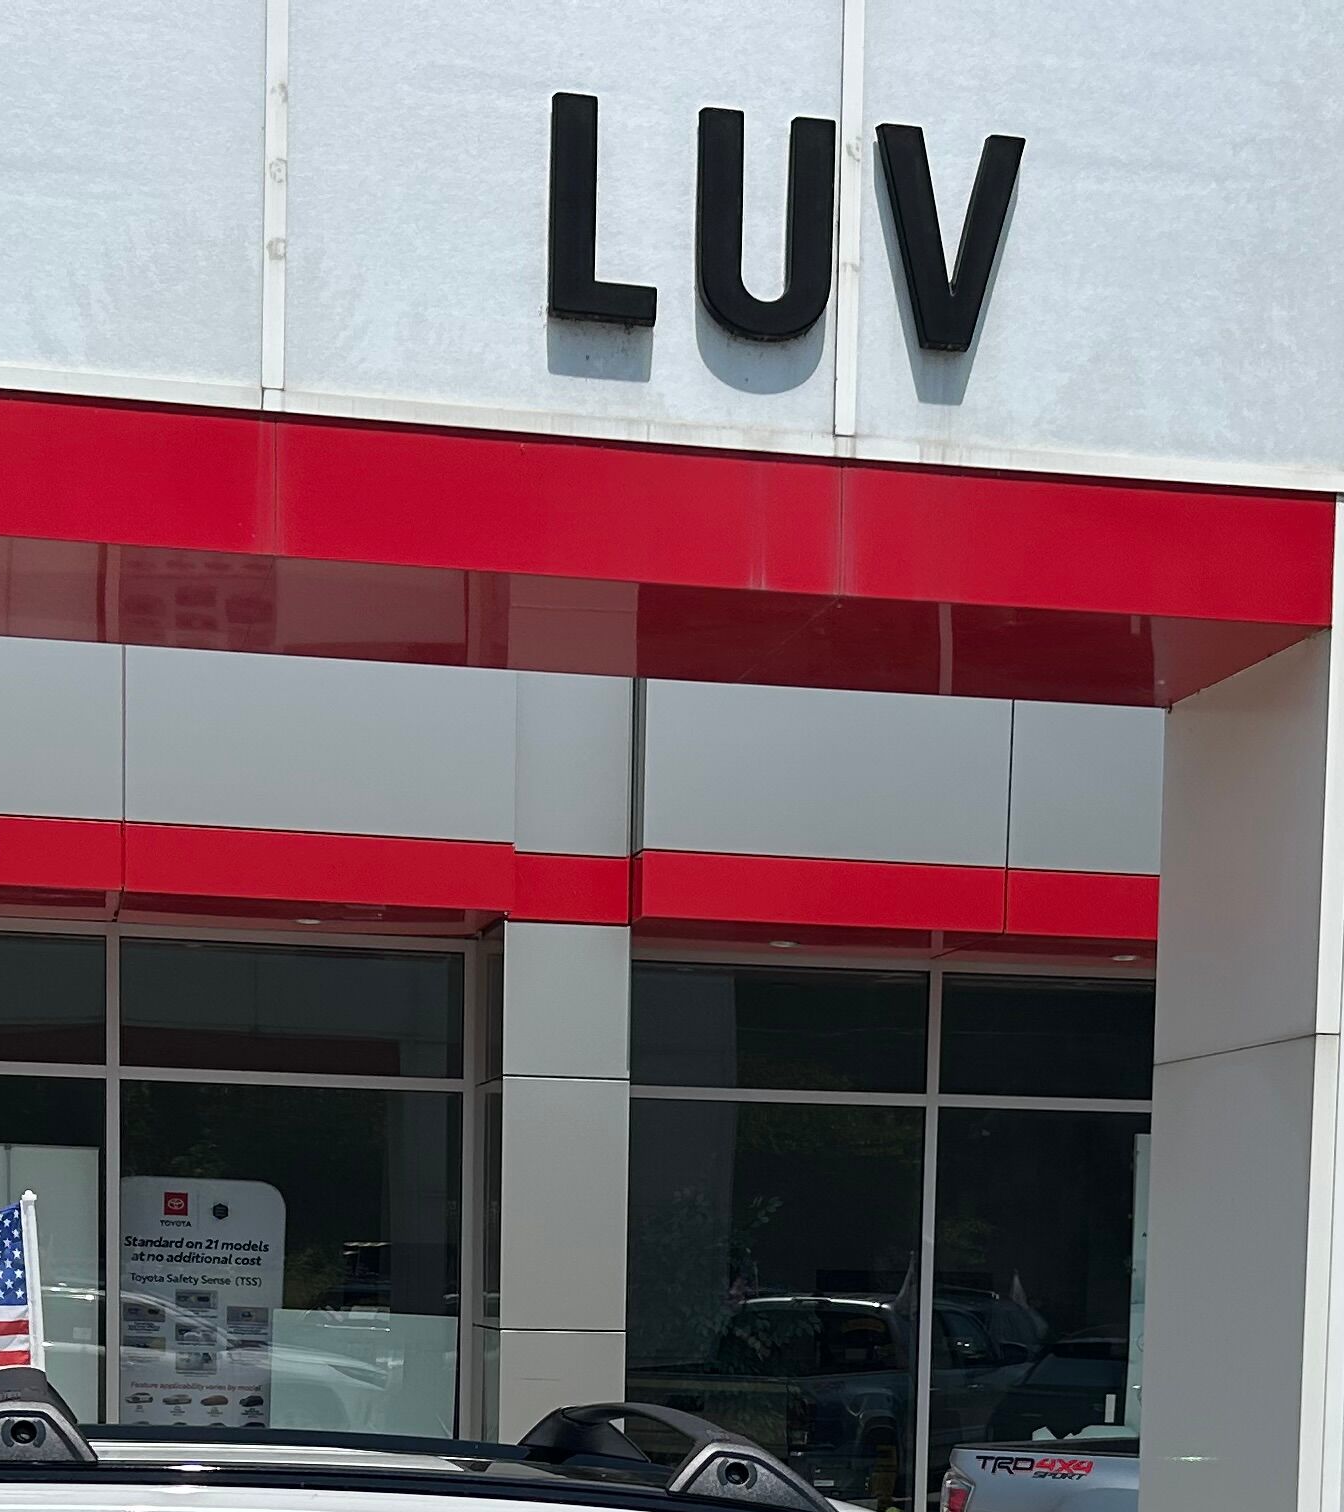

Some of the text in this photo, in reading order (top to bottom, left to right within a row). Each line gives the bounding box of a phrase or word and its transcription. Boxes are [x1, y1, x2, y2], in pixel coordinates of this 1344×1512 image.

[548, 92, 1026, 353] LUV
[159, 1219, 192, 1228] TOYOTA
[123, 1236, 270, 1253] Standard on 21 models
[131, 1252, 263, 1266] at no additional cost
[130, 1272, 263, 1288] Toyota Safety Sense (TSS)
[975, 1455, 1035, 1475] TRD
[1032, 1471, 1089, 1481] SPORT
